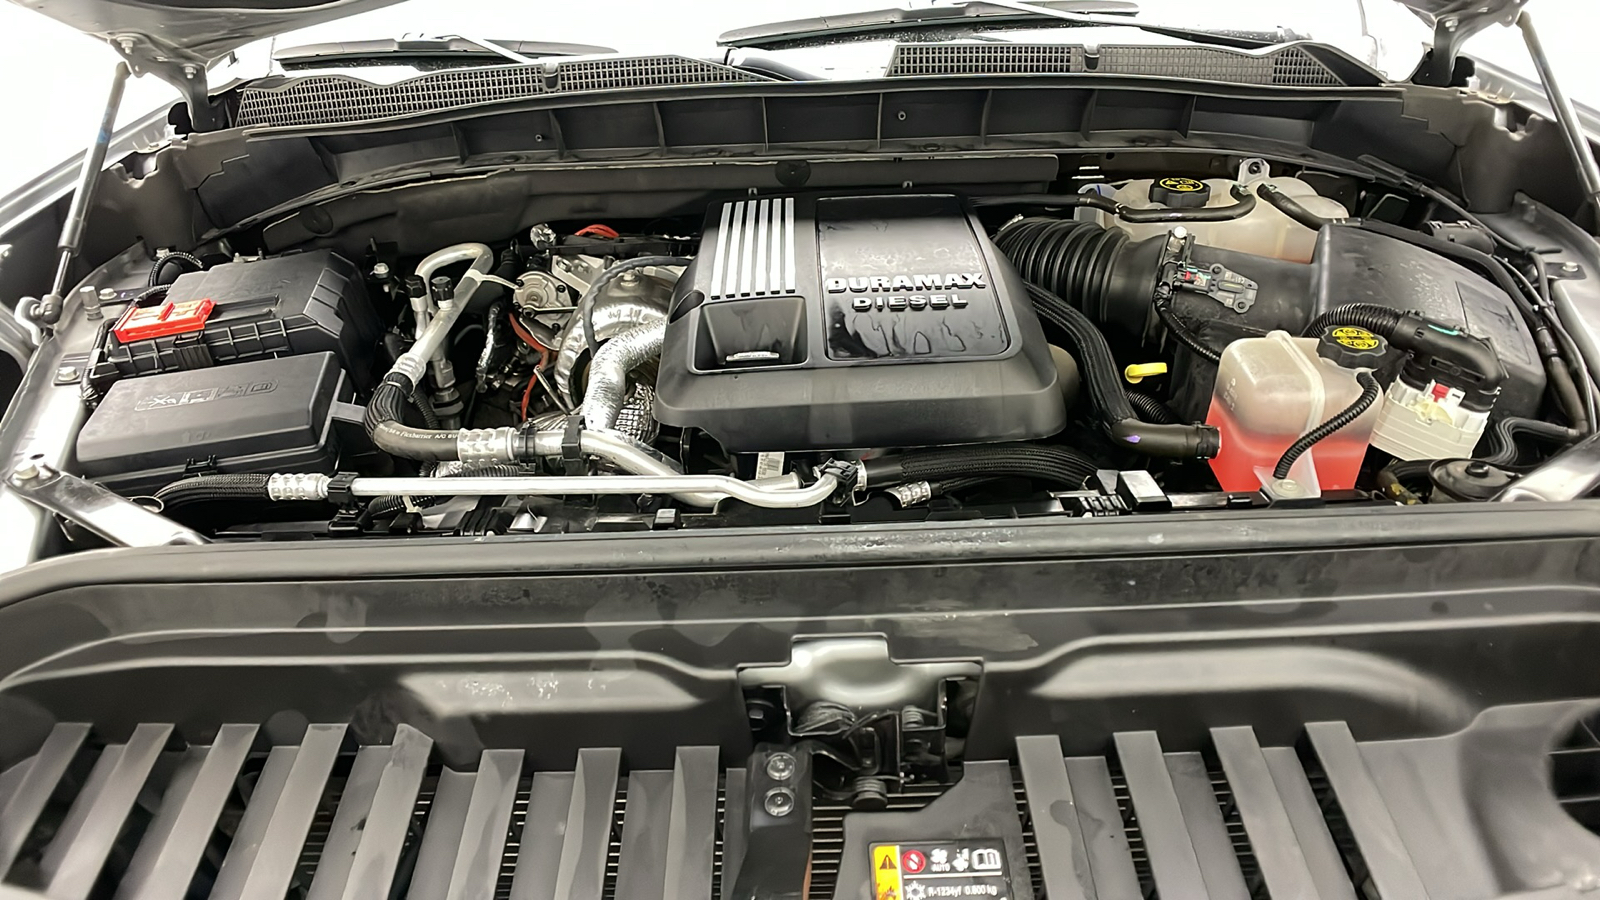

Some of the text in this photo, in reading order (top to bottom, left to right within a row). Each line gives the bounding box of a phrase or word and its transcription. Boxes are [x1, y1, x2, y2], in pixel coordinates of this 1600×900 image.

[826, 274, 987, 293] DURAMAX
[852, 294, 968, 311] DIESEL
[931, 863, 950, 872] AUTO
[927, 886, 961, 898] R-1234yf
[987, 885, 998, 896] kg
